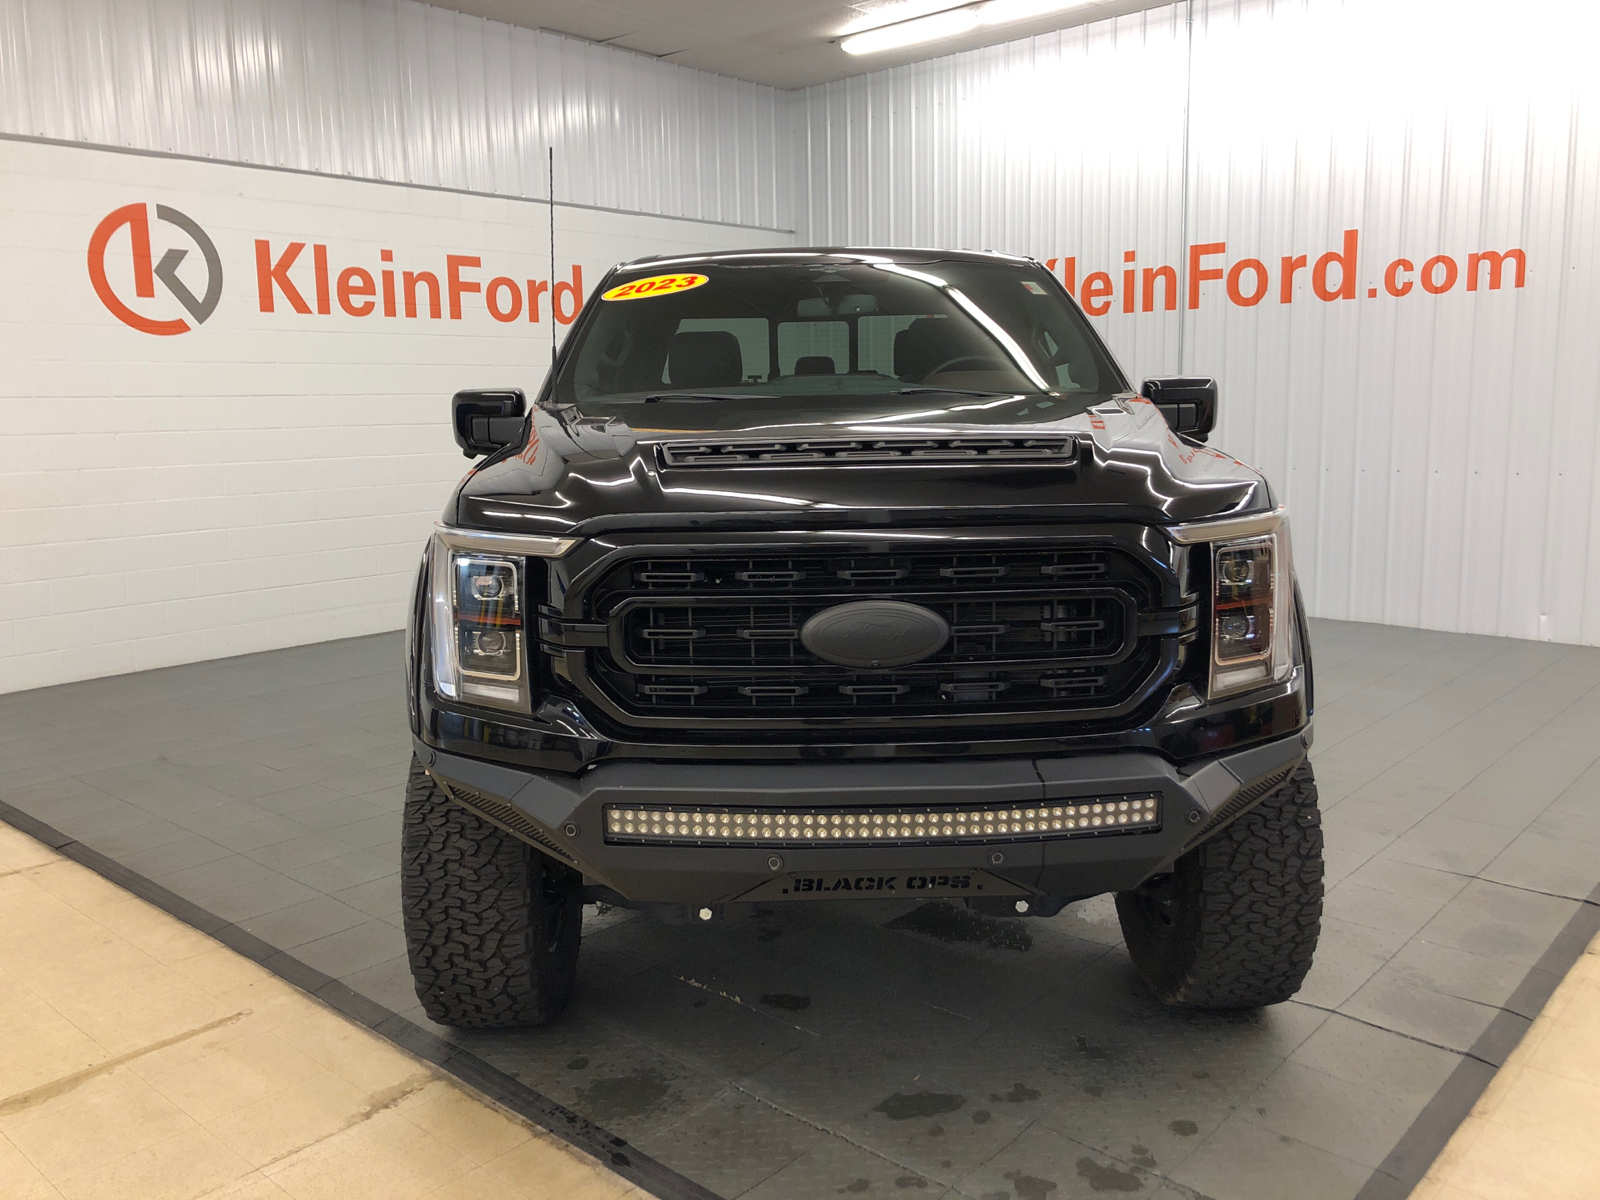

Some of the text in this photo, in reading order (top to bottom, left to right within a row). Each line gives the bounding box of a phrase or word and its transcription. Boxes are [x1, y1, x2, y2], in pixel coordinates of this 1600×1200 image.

[255, 239, 584, 325] KleinFord
[612, 275, 699, 299] 2023
[793, 875, 972, 892] BLACK OPS
